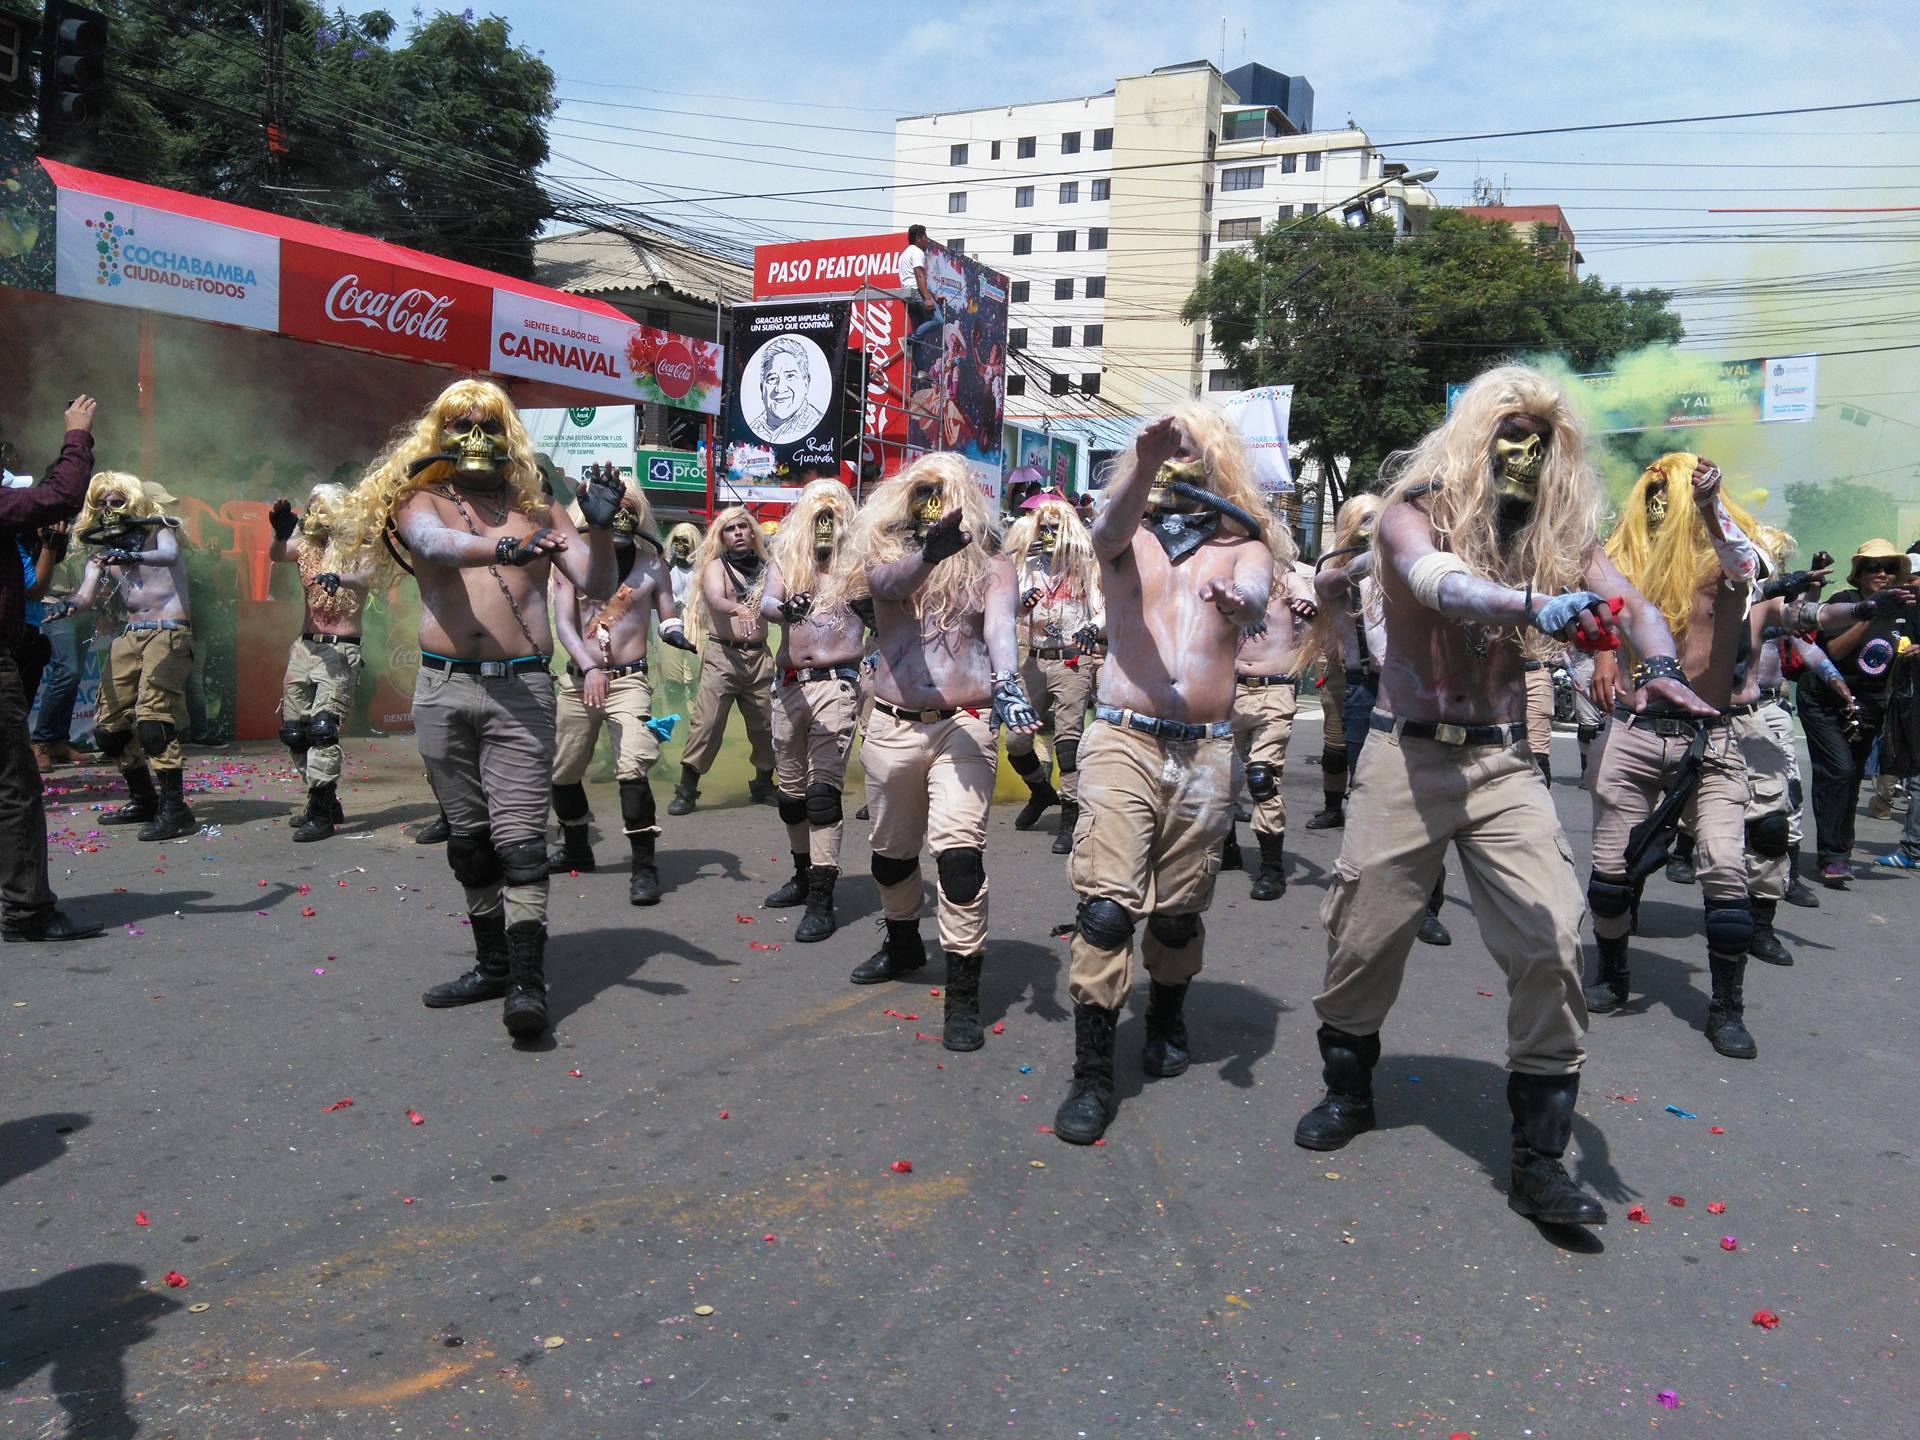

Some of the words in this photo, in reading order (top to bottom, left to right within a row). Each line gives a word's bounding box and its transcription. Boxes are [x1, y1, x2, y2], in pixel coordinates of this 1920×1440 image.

[123, 244, 257, 286] COCHABAMBA
[768, 259, 811, 284] PASO
[815, 251, 900, 280] PEATONAL
[123, 264, 181, 287] CIUDAD
[195, 278, 245, 299] TODOS
[325, 274, 456, 341] Coca-Cola
[755, 316, 783, 324] GRACIAS
[783, 315, 797, 323] POR
[798, 314, 830, 322] IMPULSAR
[524, 319, 550, 333] SIENTE
[551, 325, 561, 335] EL
[562, 327, 586, 340] SABOR
[587, 333, 601, 344] DEL
[762, 323, 784, 331] SUEÑO
[785, 322, 799, 330] QUE
[499, 331, 621, 379] CARNAVAL
[657, 359, 693, 381] Coca-Cola
[1682, 397, 1690, 409] Y
